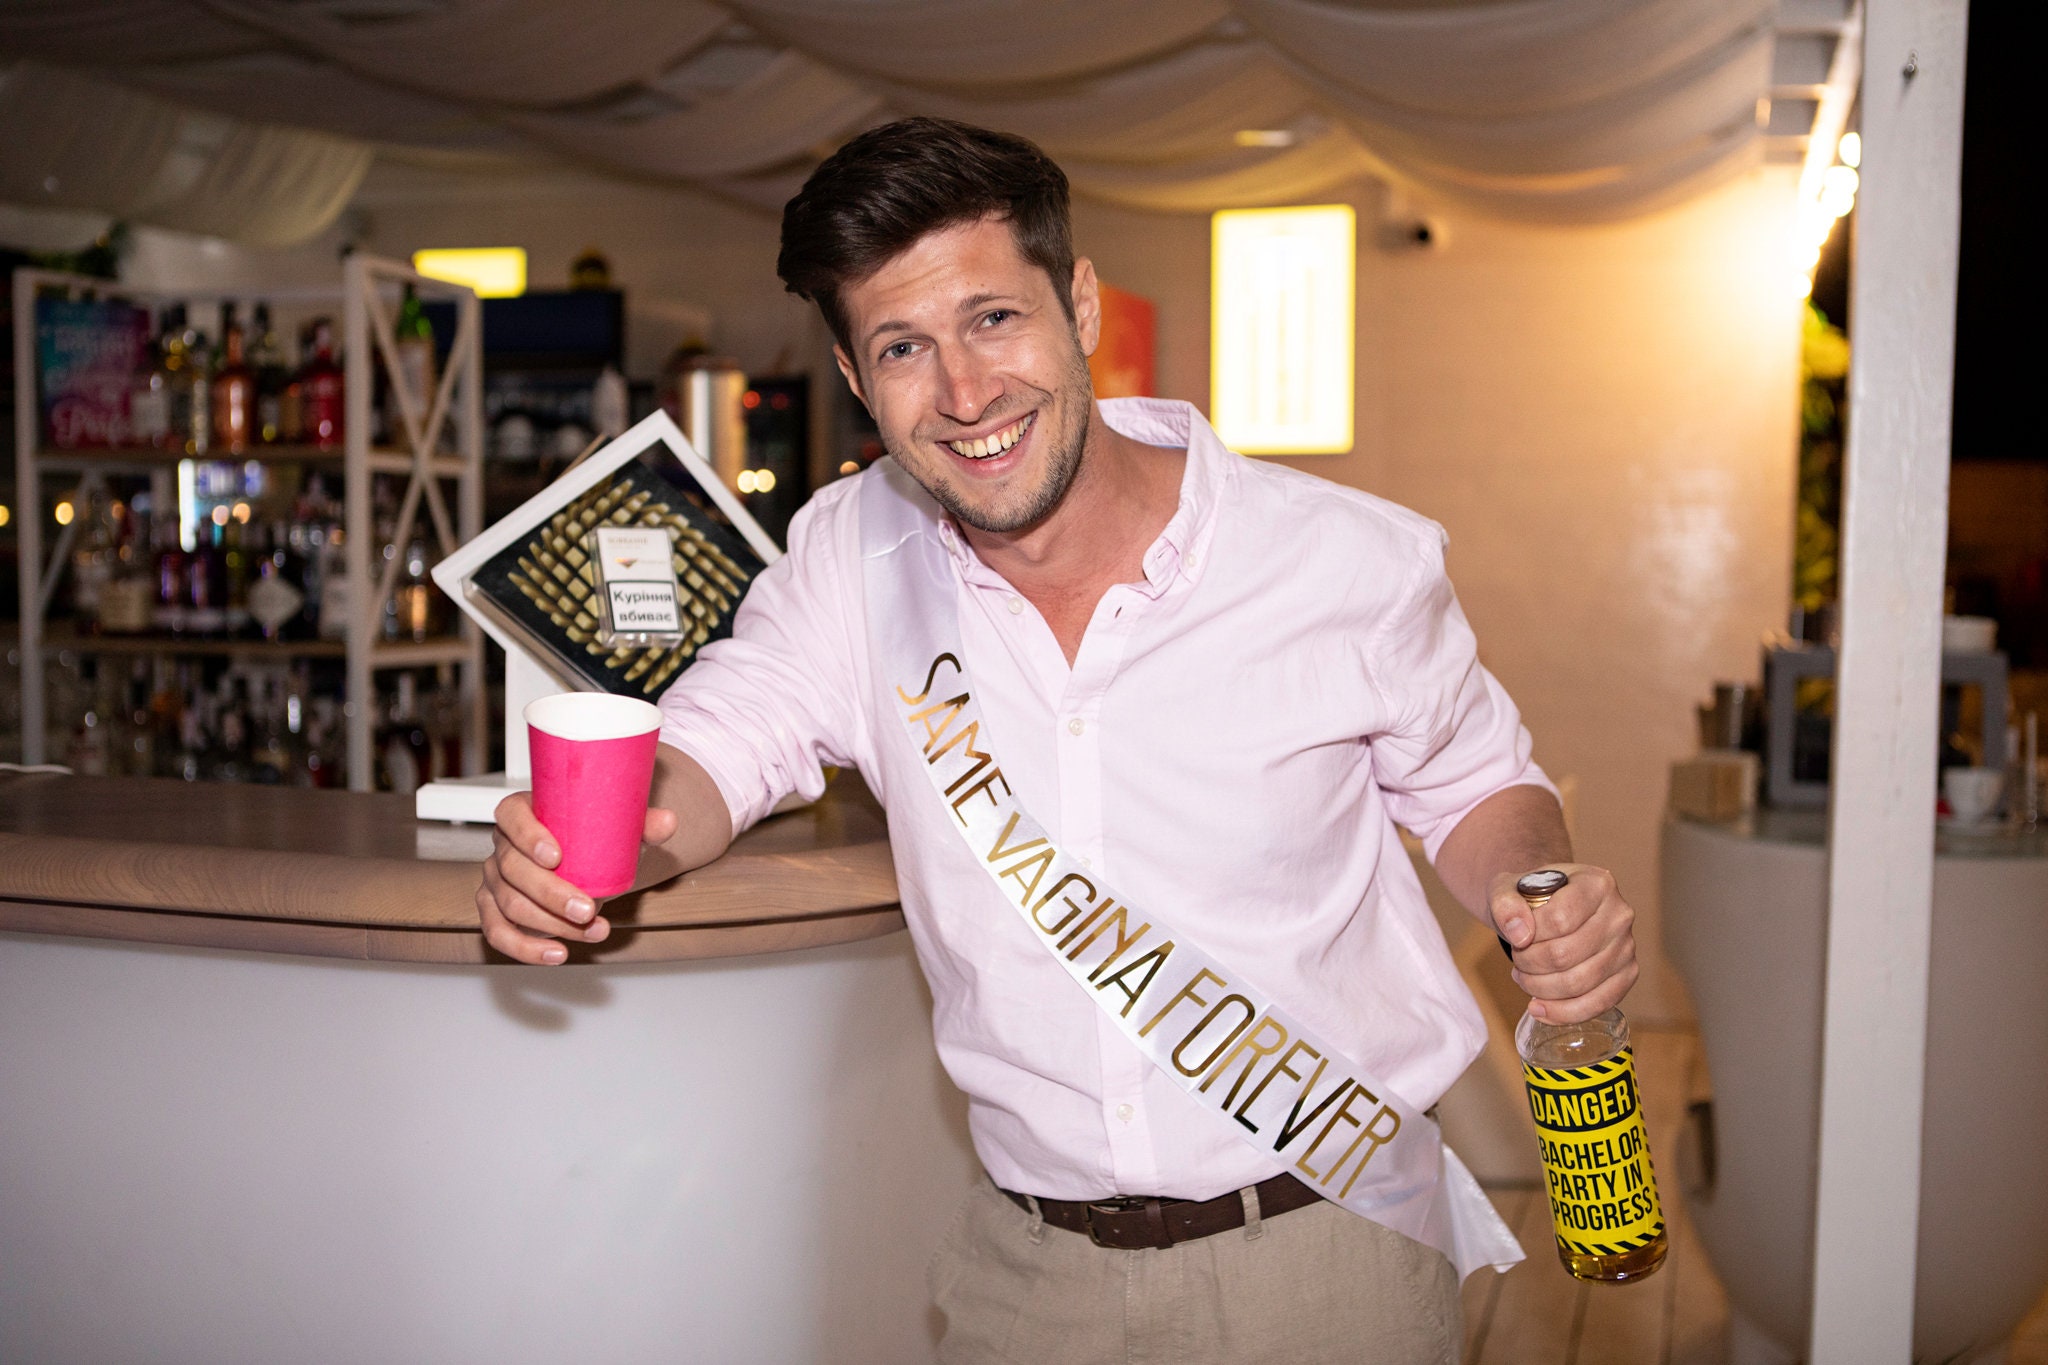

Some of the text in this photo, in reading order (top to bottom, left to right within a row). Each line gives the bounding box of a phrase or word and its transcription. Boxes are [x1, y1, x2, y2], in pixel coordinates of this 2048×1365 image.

[613, 590, 672, 604] Куріння
[620, 610, 672, 622] вбиває
[897, 652, 1402, 1200] SAME VAGINA FOREVER
[1530, 1079, 1632, 1127] DANGER
[1538, 1125, 1643, 1170] BACHELOR
[1548, 1159, 1643, 1201] PARTY IN
[1550, 1187, 1653, 1231] PROGRESS
